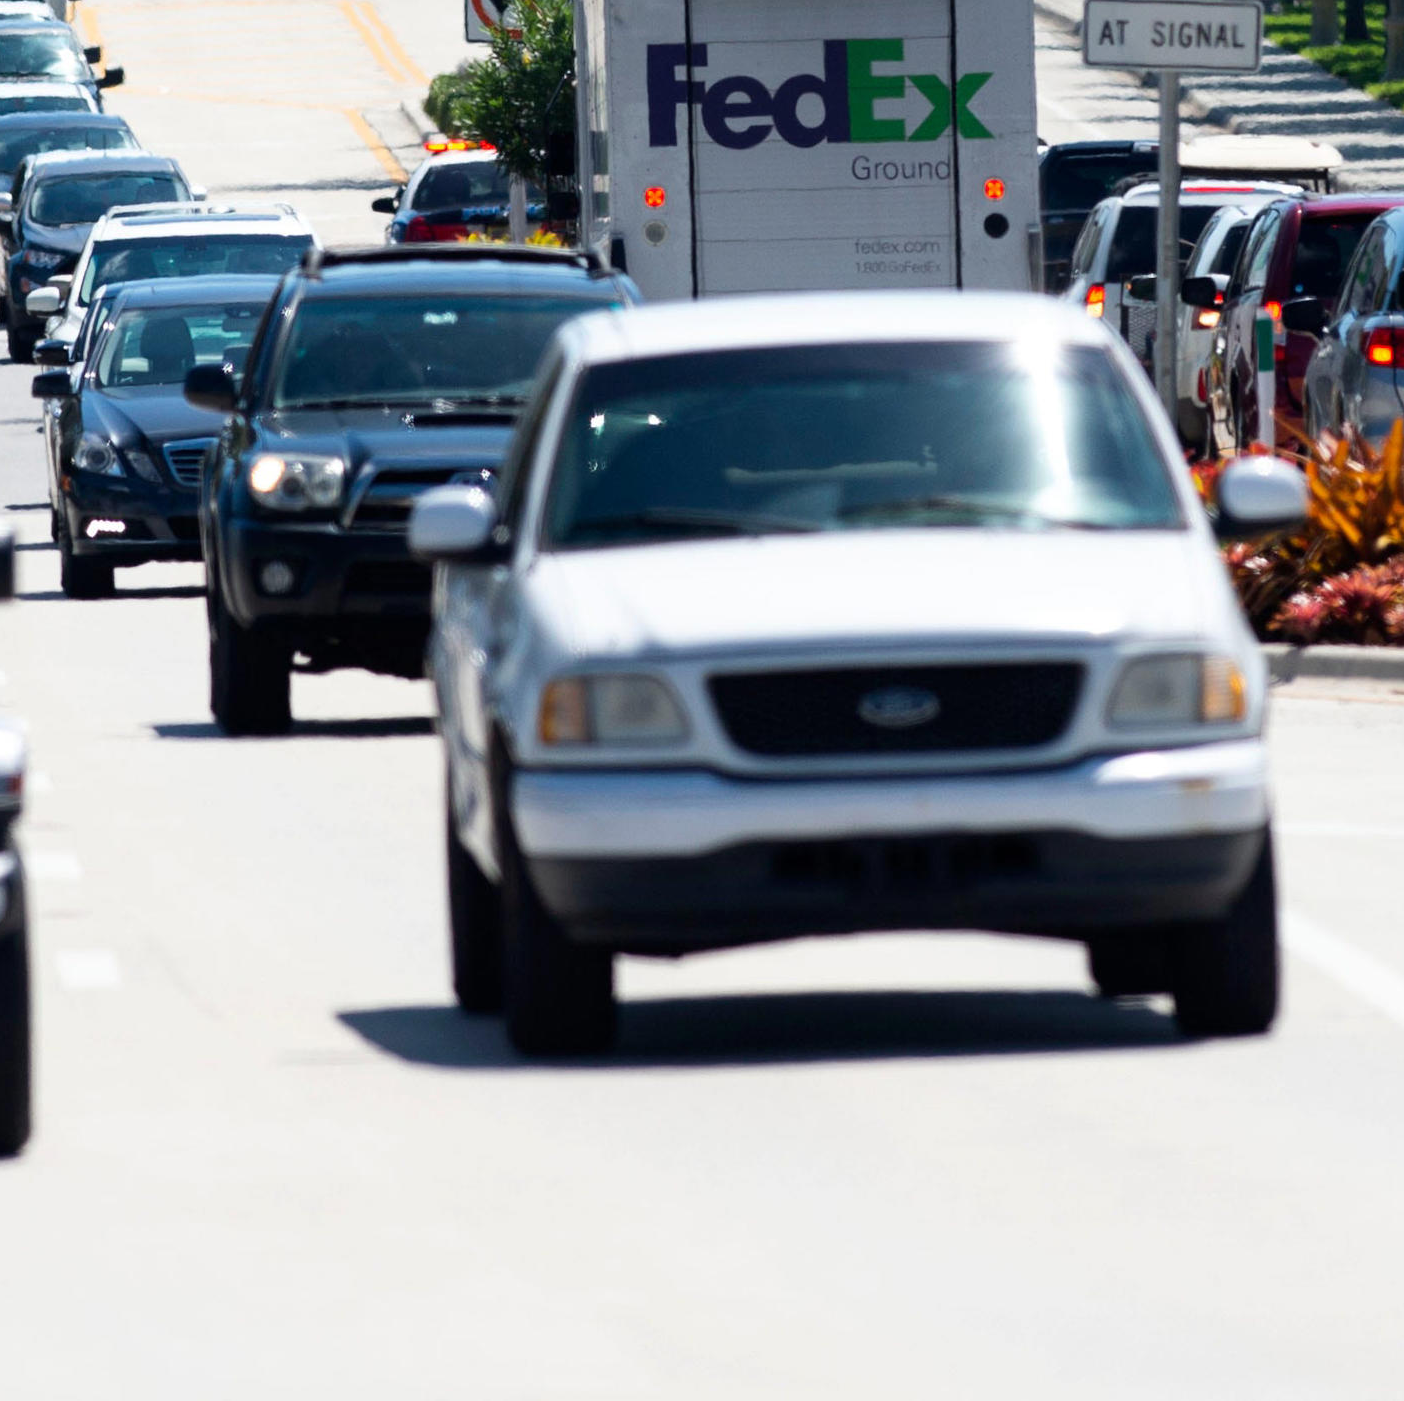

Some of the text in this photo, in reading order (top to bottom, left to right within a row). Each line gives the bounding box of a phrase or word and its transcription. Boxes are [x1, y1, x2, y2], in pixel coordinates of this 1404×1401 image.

[1099, 20, 1246, 49] AT SIGNAL
[646, 38, 995, 149] FedEx
[851, 155, 951, 182] Ground
[854, 239, 941, 254] fedex.com
